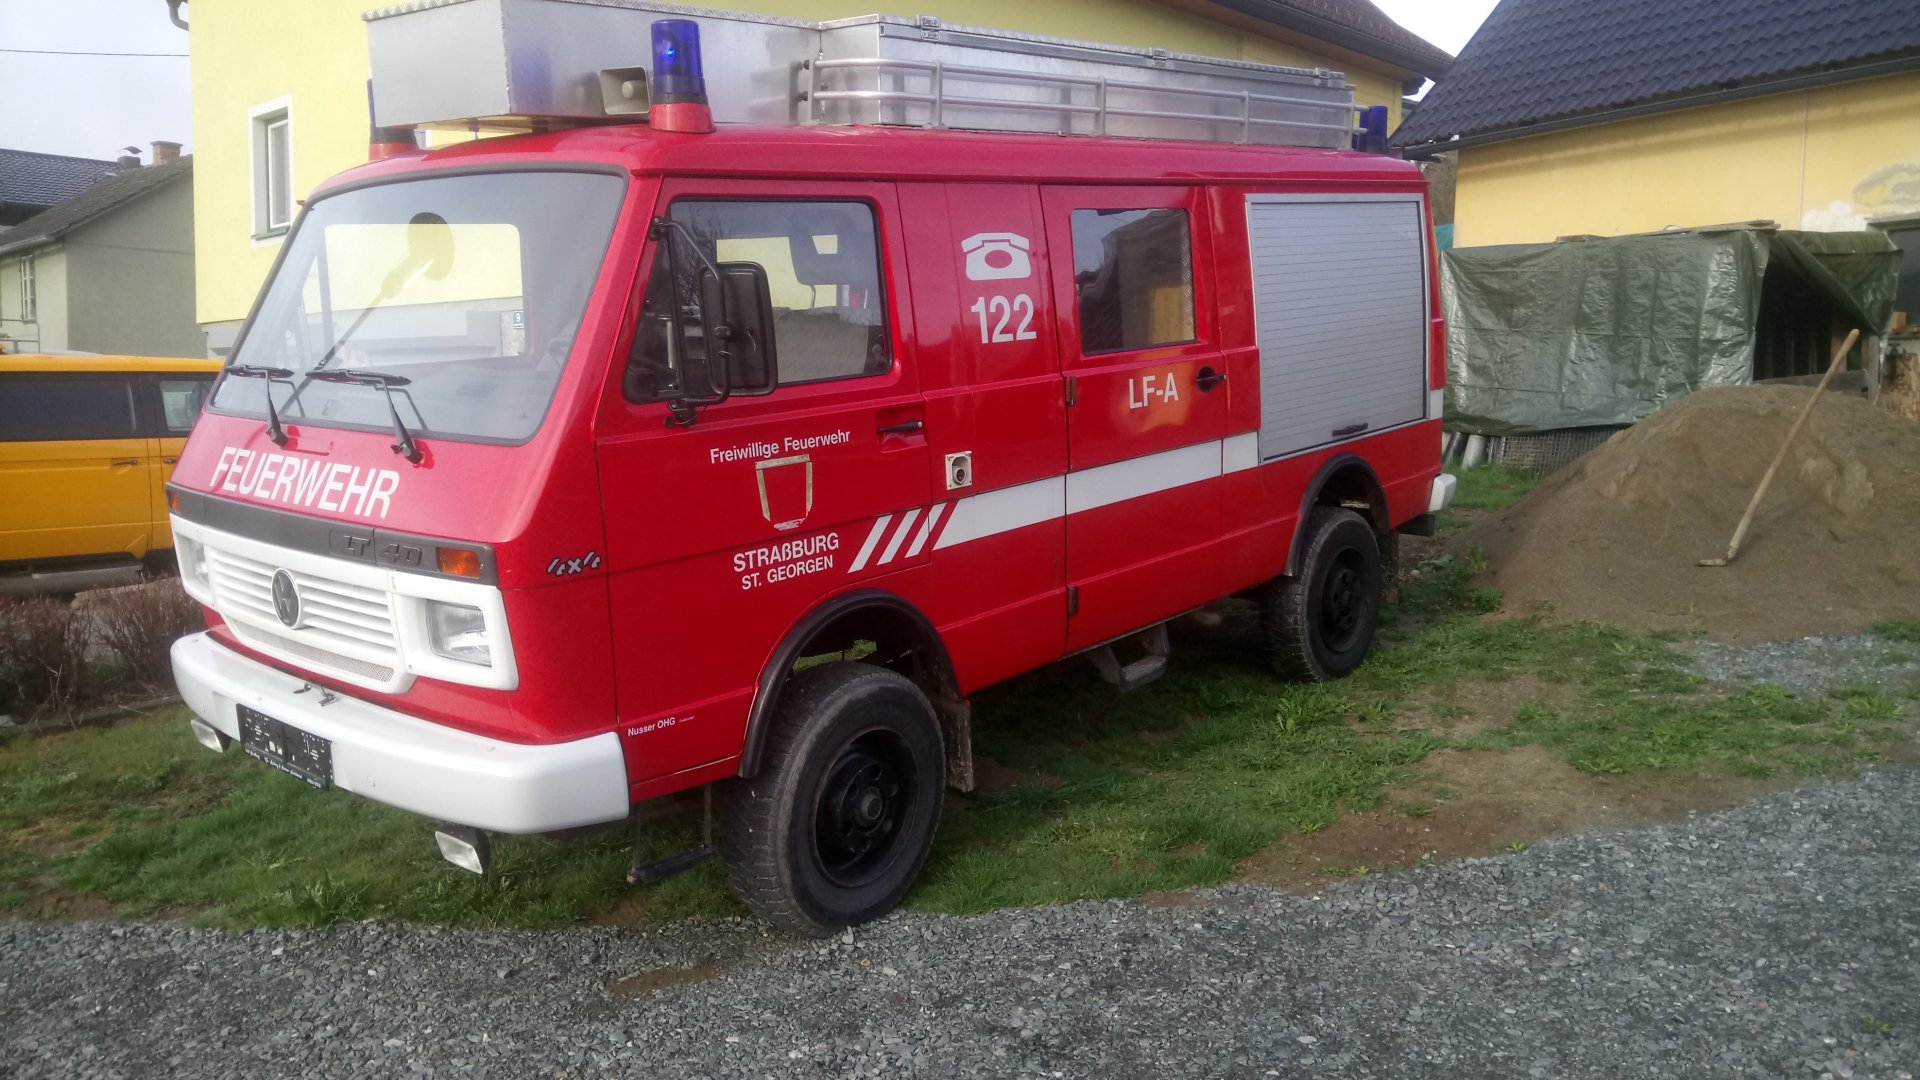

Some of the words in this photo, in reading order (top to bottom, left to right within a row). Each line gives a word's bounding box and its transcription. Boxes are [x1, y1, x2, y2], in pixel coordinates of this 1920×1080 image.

[515, 312, 521, 323] 9
[970, 293, 1037, 344] 122
[1128, 372, 1179, 409] LF-A
[710, 440, 780, 464] Freiwillige
[784, 429, 850, 453] Feuerwehr
[209, 446, 400, 518] FEUERWEHR
[733, 532, 840, 573] STRAßBURG
[741, 573, 762, 590] ST.
[766, 554, 833, 584] GEORGEN
[627, 723, 656, 737] Nusser
[657, 717, 676, 729] OHG
